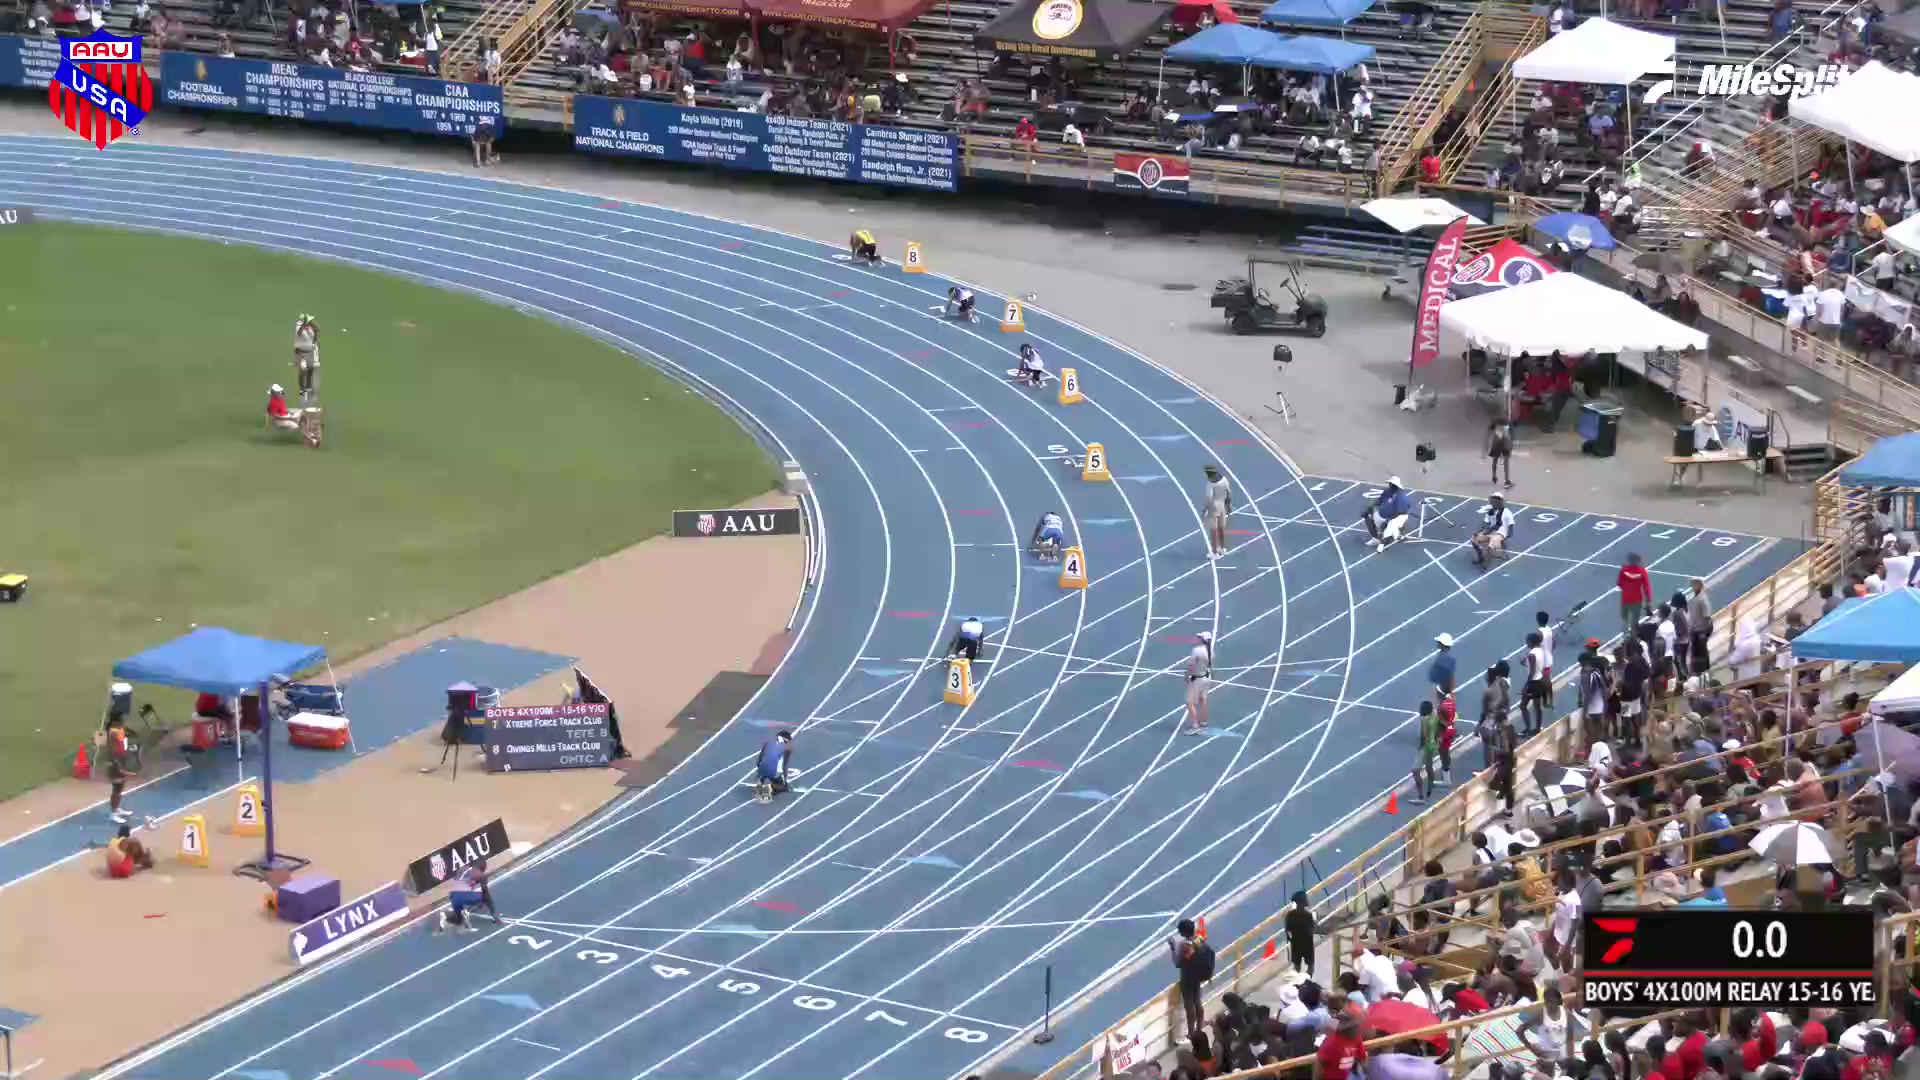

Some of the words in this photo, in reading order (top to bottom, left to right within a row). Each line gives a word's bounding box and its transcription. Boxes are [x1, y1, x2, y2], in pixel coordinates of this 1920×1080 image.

[271, 63, 298, 76] MEAC
[180, 81, 224, 94] FOOTBALL
[245, 72, 324, 91] CHAMPIONSHIPS
[345, 72, 365, 83] BLACK
[365, 75, 395, 86] COLLEGE
[328, 80, 358, 92] NATIONAL
[359, 83, 412, 97] CHAMPIONSHIPS
[445, 84, 469, 98] CIAA
[167, 90, 238, 107] CHAMPIONSHIPS
[415, 94, 500, 114] CHAMPIONSHIPS
[681, 113, 700, 124] Kayla
[700, 115, 720, 126] White
[721, 117, 744, 130] (2019)
[765, 115, 785, 125] 4x400
[786, 118, 808, 127] Indoor
[809, 119, 828, 129] Team
[829, 122, 852, 134] (2021)
[591, 126, 618, 139] TRACK
[619, 131, 625, 139] &
[626, 131, 649, 142] FIELD
[898, 131, 923, 143] Sturgis
[924, 134, 948, 146] (2021)
[576, 136, 615, 149] NATIONAL
[616, 141, 665, 155] CHAMPIONS
[762, 143, 784, 154] 4x400
[784, 147, 812, 157] Outdoor
[812, 149, 831, 159] Team
[832, 152, 855, 164] (2021)
[862, 160, 895, 172] Randolph
[928, 168, 952, 180] (2021)
[909, 251, 917, 263] 8
[1419, 236, 1458, 351] MEDICAL
[1008, 309, 1017, 321] 7
[1067, 378, 1075, 391] 6
[1091, 454, 1100, 468] 5
[721, 513, 776, 532] AAU
[1531, 512, 1560, 524] 5
[1591, 520, 1618, 532] 6
[1650, 528, 1678, 539] 7
[1710, 536, 1738, 548] 8
[1067, 559, 1078, 575] 4
[951, 672, 960, 689] 3
[487, 707, 515, 718] BOYS
[516, 706, 553, 716] 4X100M
[561, 705, 586, 715] 15-16
[588, 704, 605, 714] Y/O
[566, 729, 595, 739] TETE
[600, 728, 608, 737] B
[492, 745, 500, 754] 8
[600, 753, 608, 763] A
[241, 801, 253, 819] 2
[186, 831, 196, 849] 1
[451, 832, 490, 872] AAU
[323, 899, 380, 940] LYNX
[508, 934, 553, 950] 2
[576, 949, 619, 964] 3
[650, 963, 691, 979] 4
[719, 979, 761, 995] 5
[792, 995, 837, 1011] 6
[864, 1010, 909, 1027] 7
[944, 1027, 989, 1044] 8
